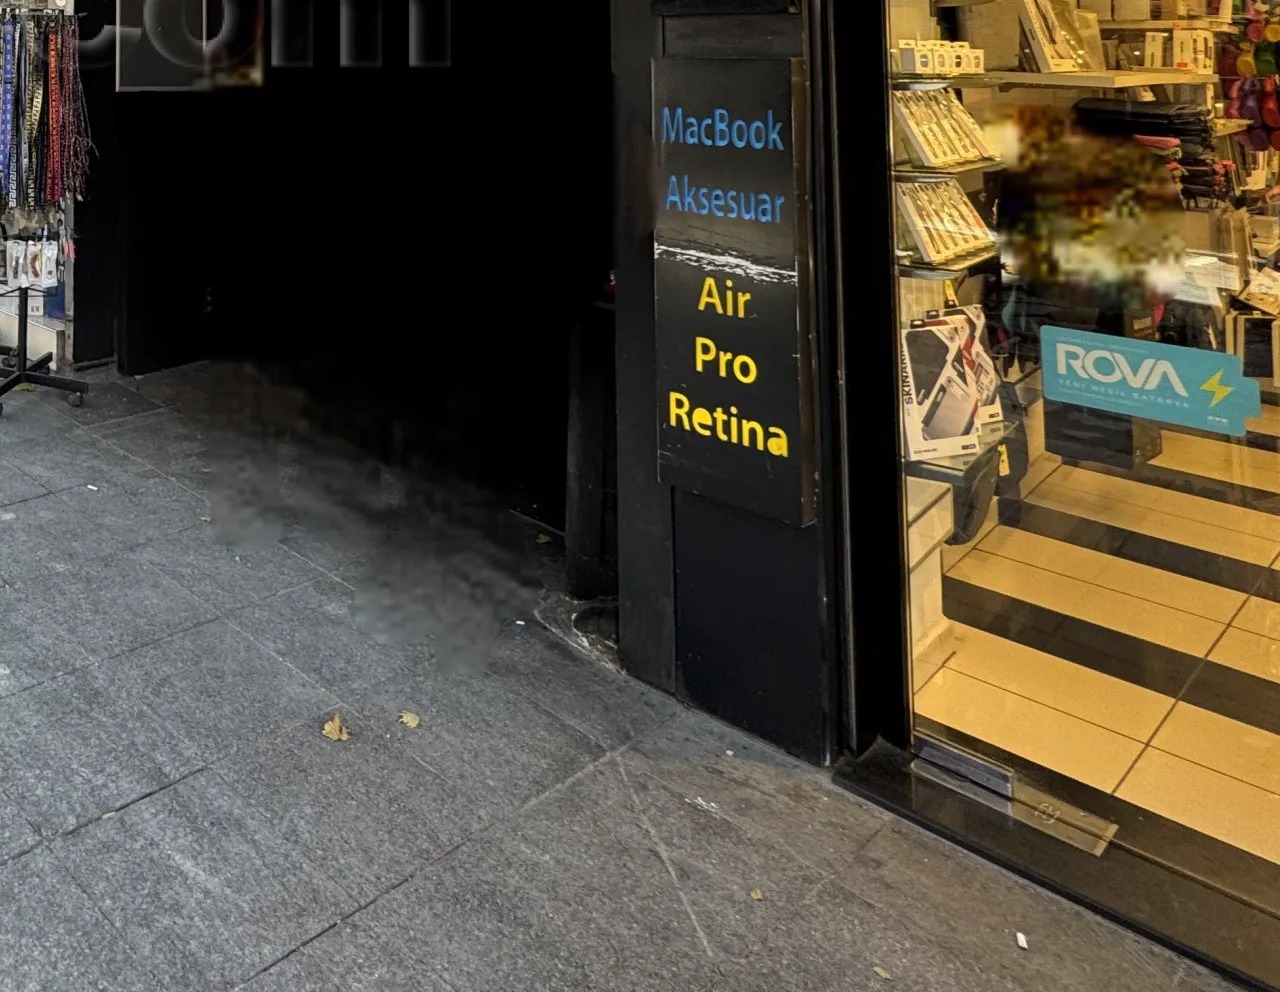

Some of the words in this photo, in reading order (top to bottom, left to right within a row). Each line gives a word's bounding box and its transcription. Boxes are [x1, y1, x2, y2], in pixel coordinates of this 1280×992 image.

[661, 106, 785, 151] MacBook
[666, 174, 785, 223] Aksesuar
[698, 277, 751, 318] Air
[695, 336, 758, 385] Pro
[1055, 342, 1189, 398] ROVA
[669, 391, 789, 458] Retina
